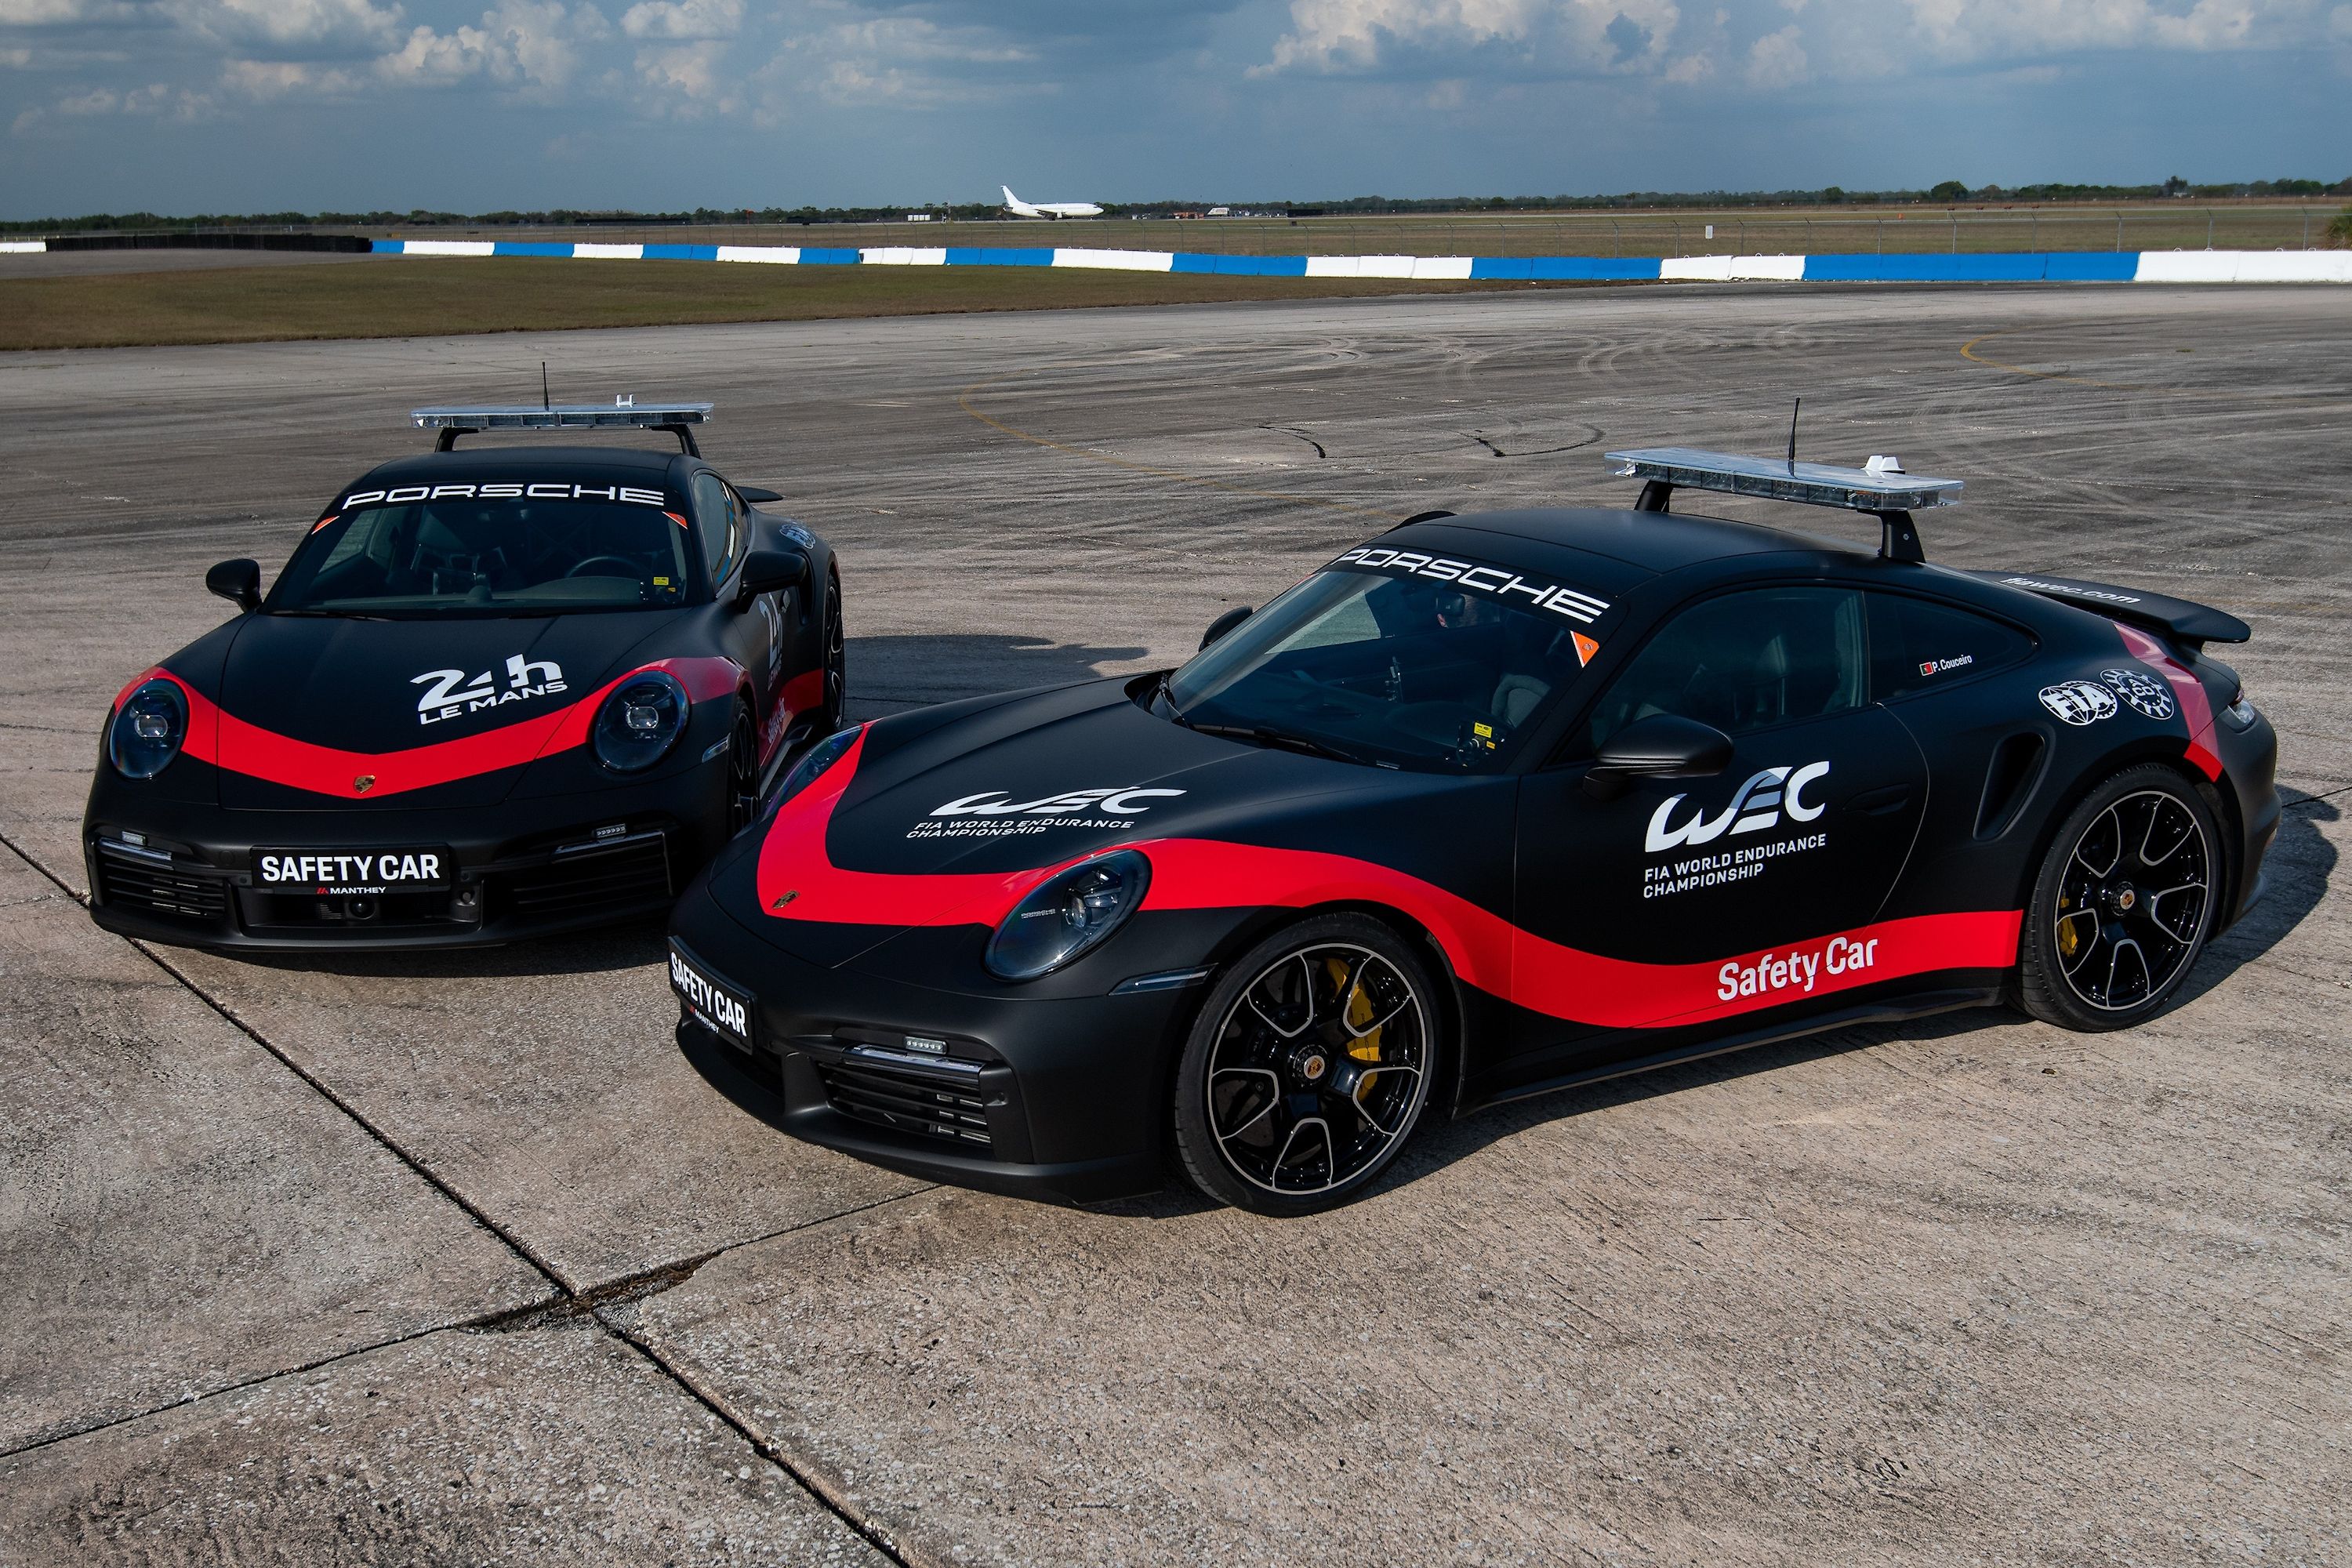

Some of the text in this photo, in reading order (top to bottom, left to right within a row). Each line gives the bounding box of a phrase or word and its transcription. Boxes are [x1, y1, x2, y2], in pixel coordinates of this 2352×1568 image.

[342, 483, 665, 510] PORSCHE
[1330, 548, 1610, 624] PORSCHE
[2000, 577, 2141, 604] fiawec.com
[1932, 654, 1973, 673] P. Couceiro
[419, 681, 568, 725] LE MANS
[928, 786, 1188, 815] WEC
[1644, 760, 1830, 853] WEC
[906, 826, 1047, 839] CHAMPIONSHIP
[913, 818, 1135, 831] FIA WORLD ENDURANCE
[261, 854, 441, 882] SAFETY CAR
[1644, 833, 1827, 883] FIA WORLD ENDURANCE
[329, 886, 387, 895] MANTHEY
[1642, 862, 1764, 899] CHAMPIONSHIP
[1717, 936, 1878, 1001] Safety Car
[670, 951, 747, 1037] SAFETY CAR
